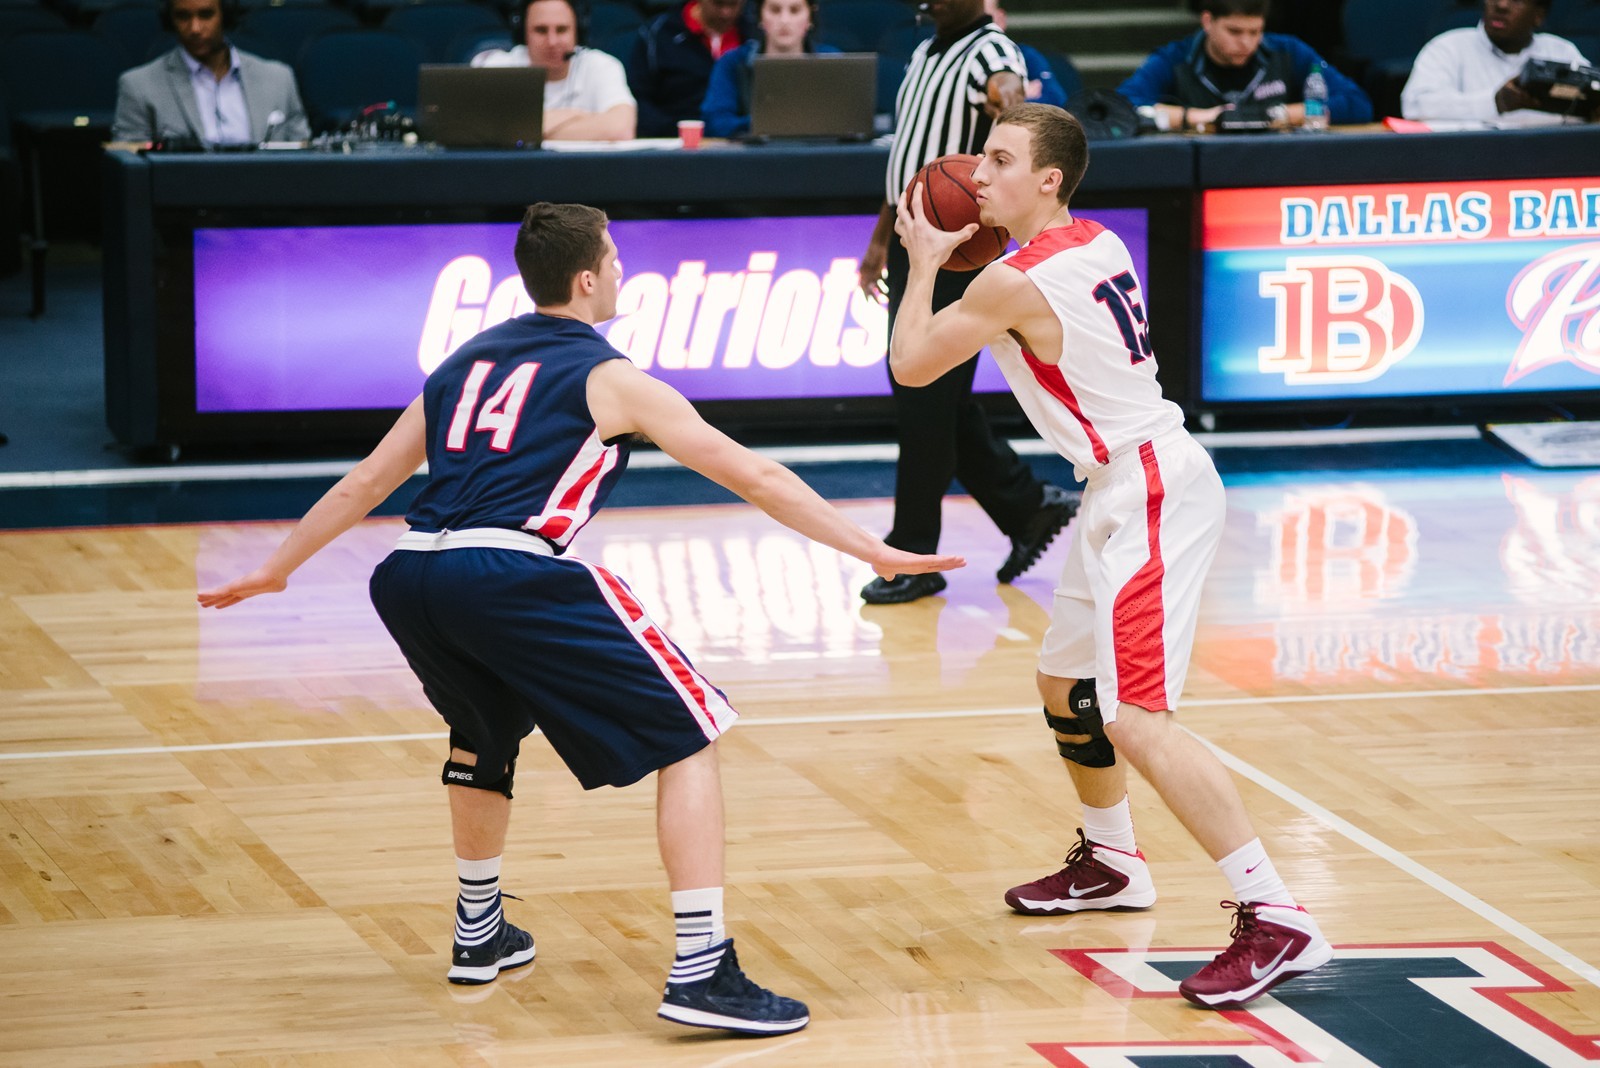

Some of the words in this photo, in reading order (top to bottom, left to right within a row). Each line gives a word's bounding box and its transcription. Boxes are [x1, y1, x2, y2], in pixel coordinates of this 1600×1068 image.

[1282, 194, 1491, 243] DALLAS
[598, 251, 888, 371] atriots
[445, 360, 541, 452] 14
